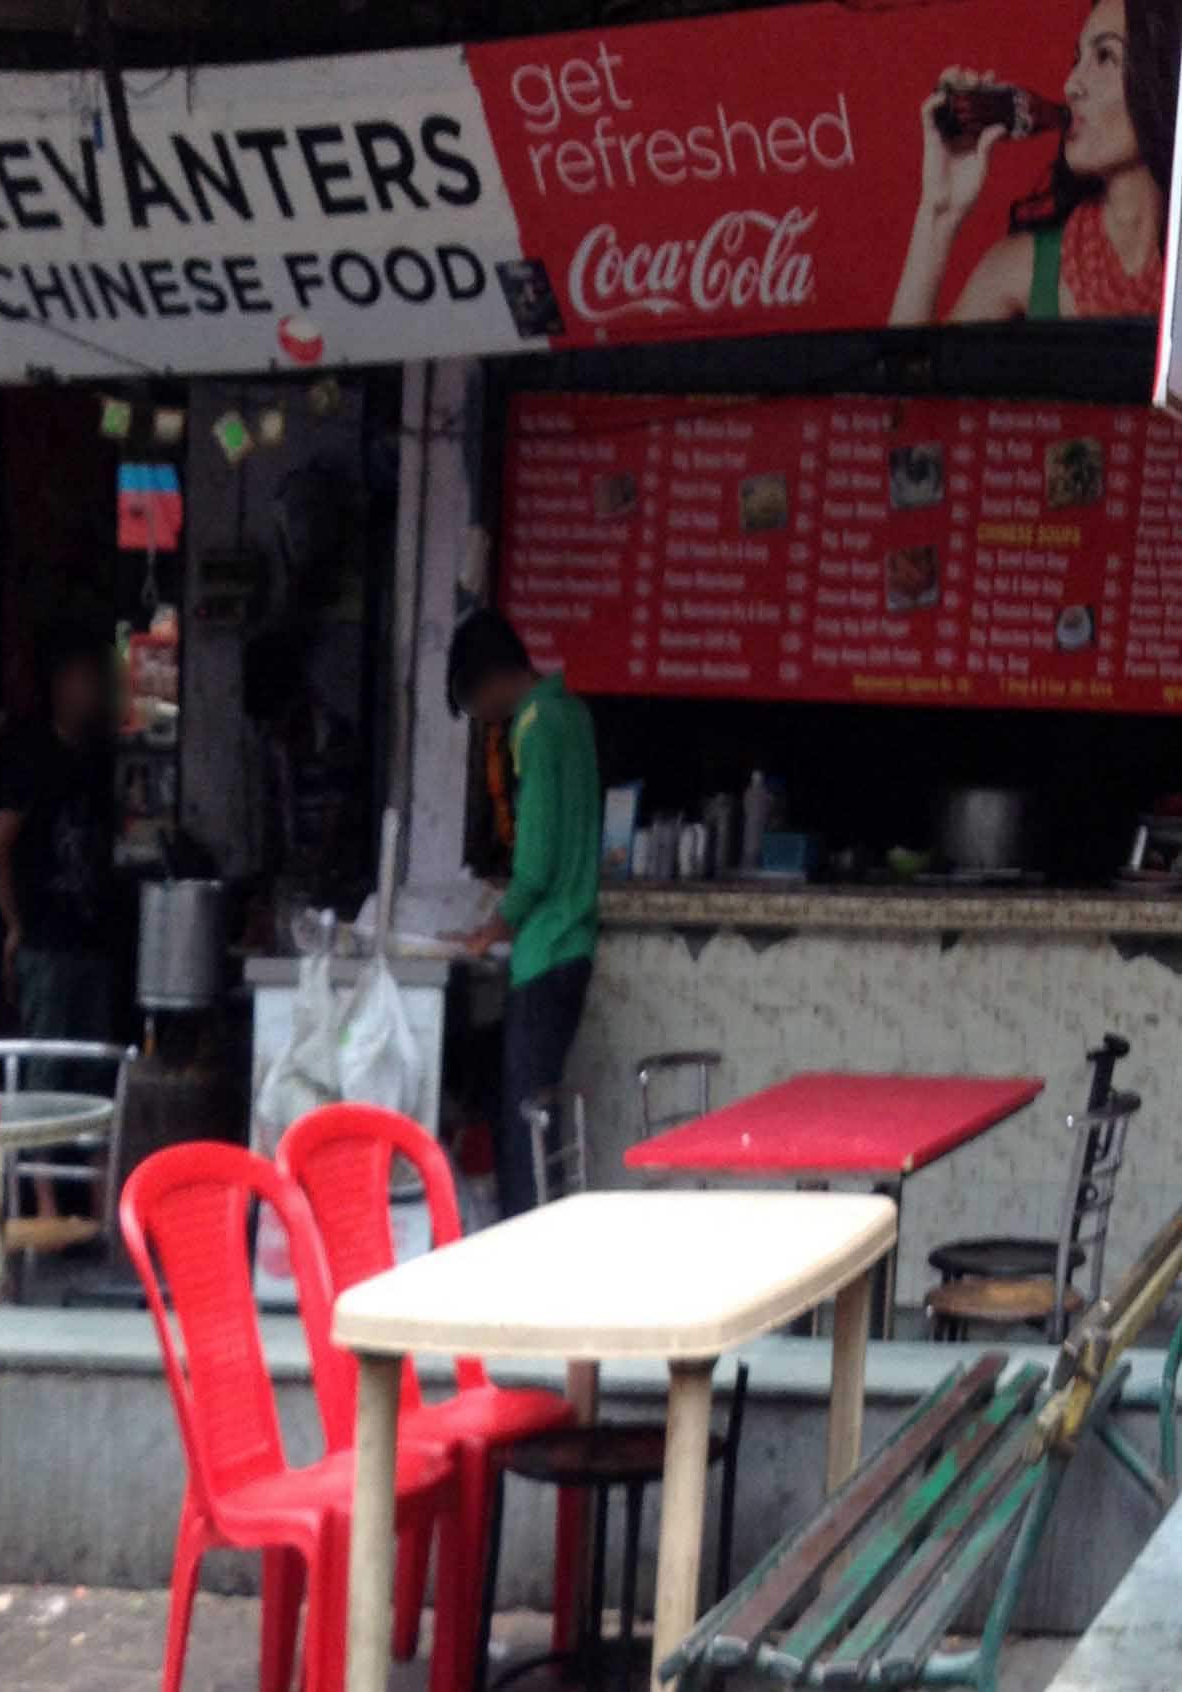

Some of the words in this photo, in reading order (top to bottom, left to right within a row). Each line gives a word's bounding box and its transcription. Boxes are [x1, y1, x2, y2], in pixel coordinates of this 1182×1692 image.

[511, 41, 633, 134] get
[529, 92, 855, 196] refreshed
[284, 244, 487, 307] FOOD
[568, 206, 817, 322] Coca-Cola
